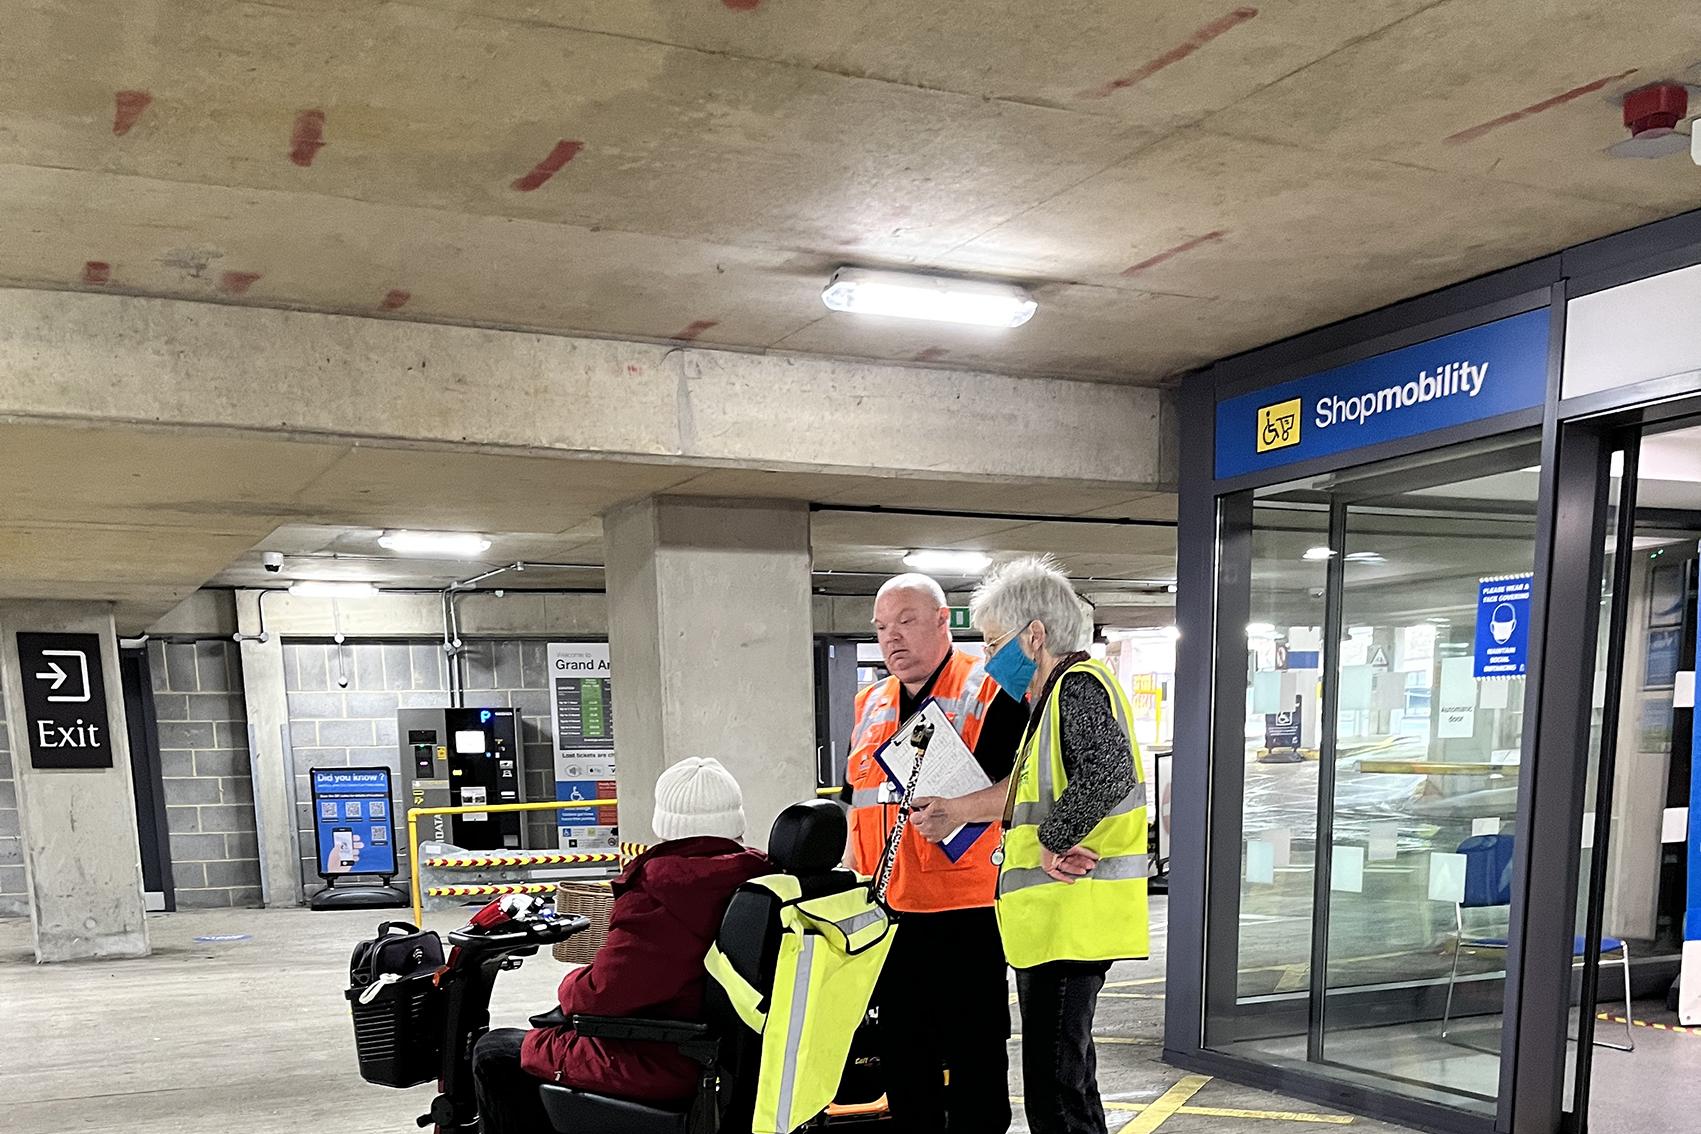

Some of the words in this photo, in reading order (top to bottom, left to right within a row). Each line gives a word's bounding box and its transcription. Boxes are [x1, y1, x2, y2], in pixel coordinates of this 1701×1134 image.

[1315, 361, 1489, 428] Shopmobility
[1482, 586, 1505, 595] PLEASE
[1505, 584, 1524, 592] WEAR
[1498, 592, 1530, 602] COVERING
[555, 659, 594, 671] Grand
[36, 718, 101, 748] Exit
[317, 773, 333, 782] Did
[334, 775, 351, 783] you
[352, 773, 378, 782] know
